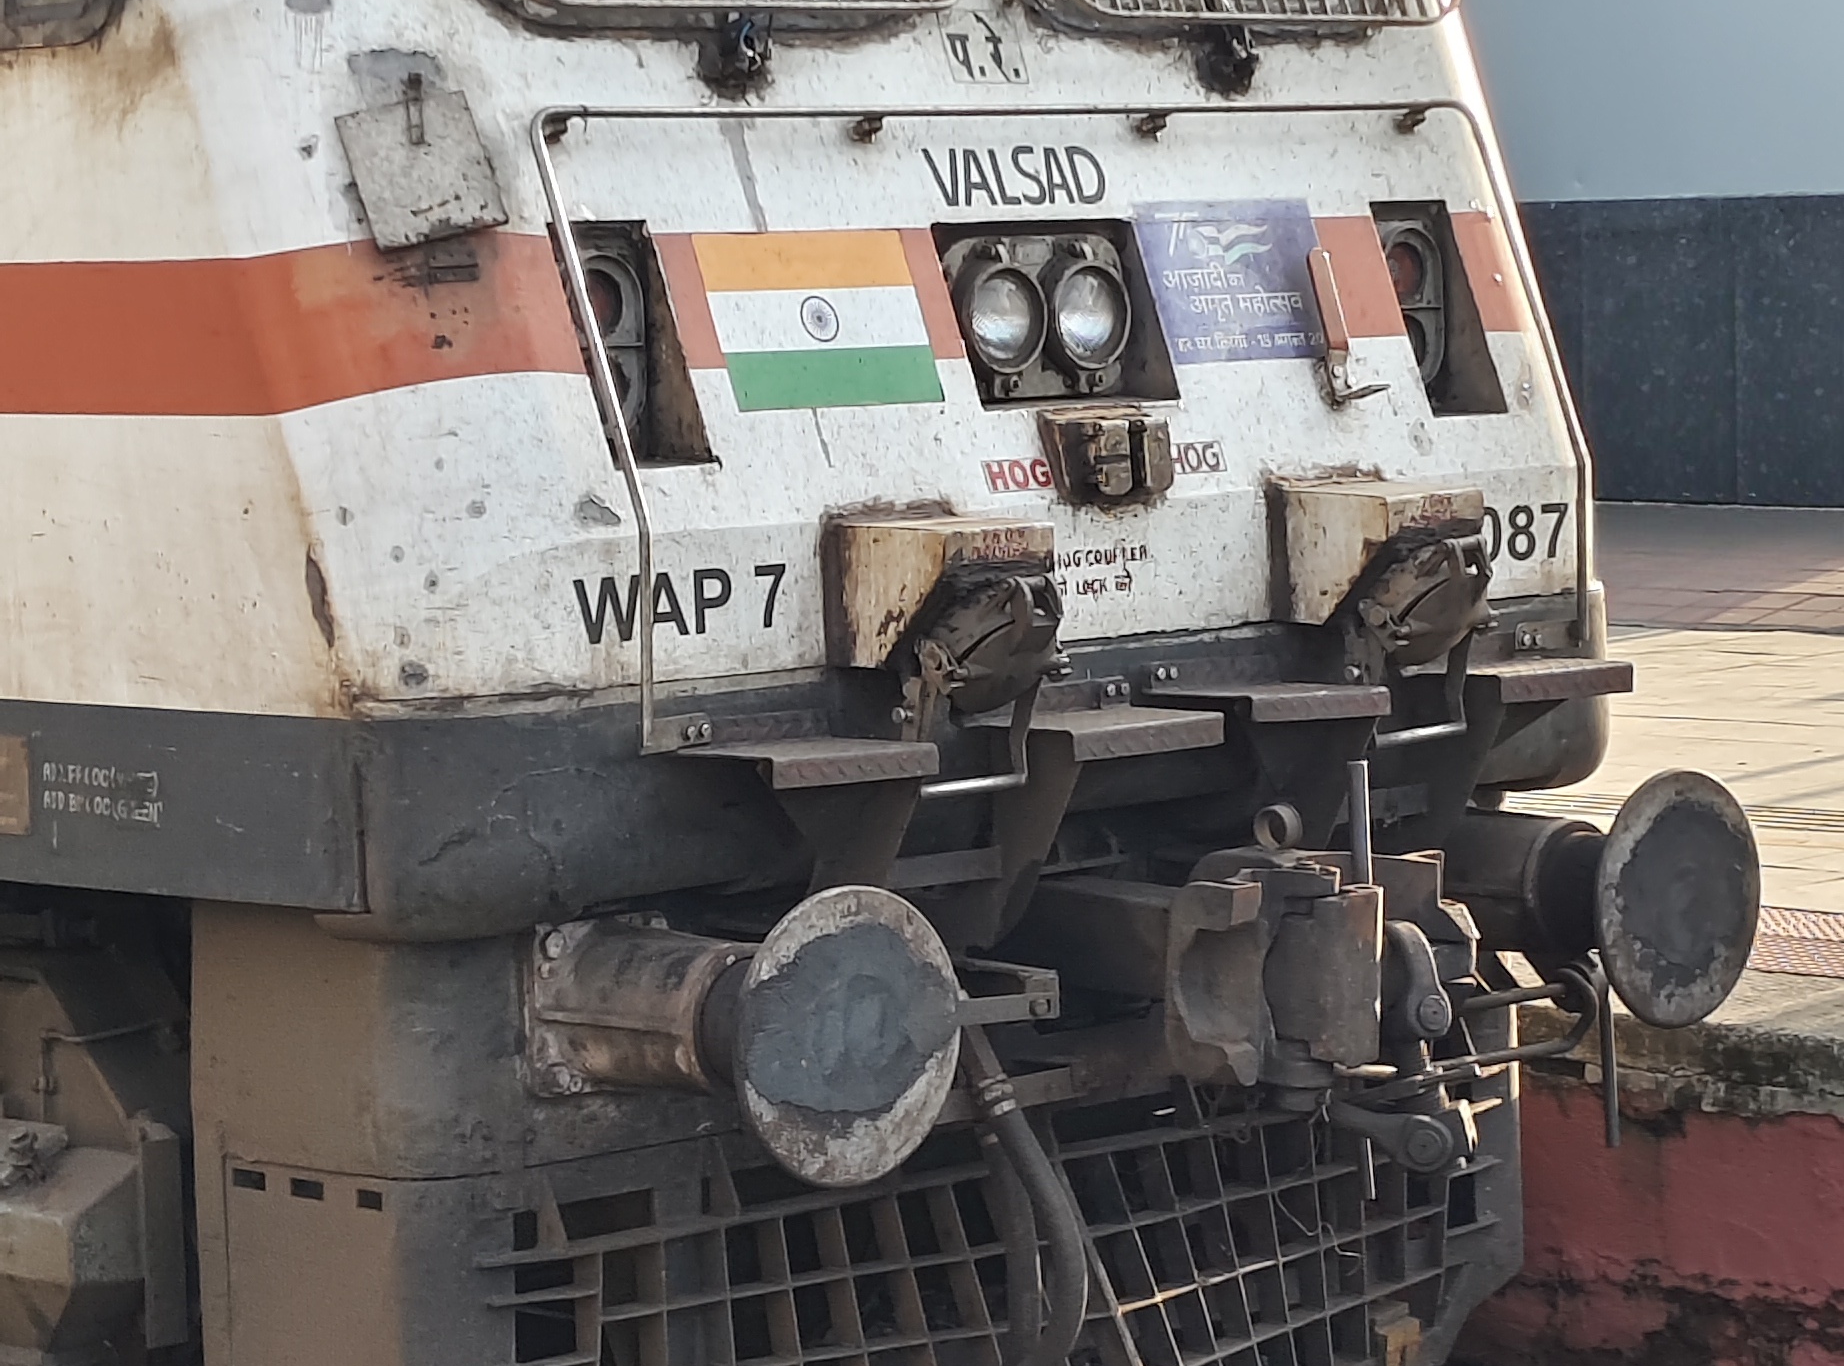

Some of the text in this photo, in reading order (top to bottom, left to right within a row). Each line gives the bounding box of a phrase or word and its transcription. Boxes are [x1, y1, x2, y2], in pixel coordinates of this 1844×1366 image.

[920, 145, 1106, 207] VALSAD
[1189, 286, 1304, 322] अमृत महोत्सव
[985, 457, 1053, 491] HOG
[572, 563, 786, 645] WAP 7
